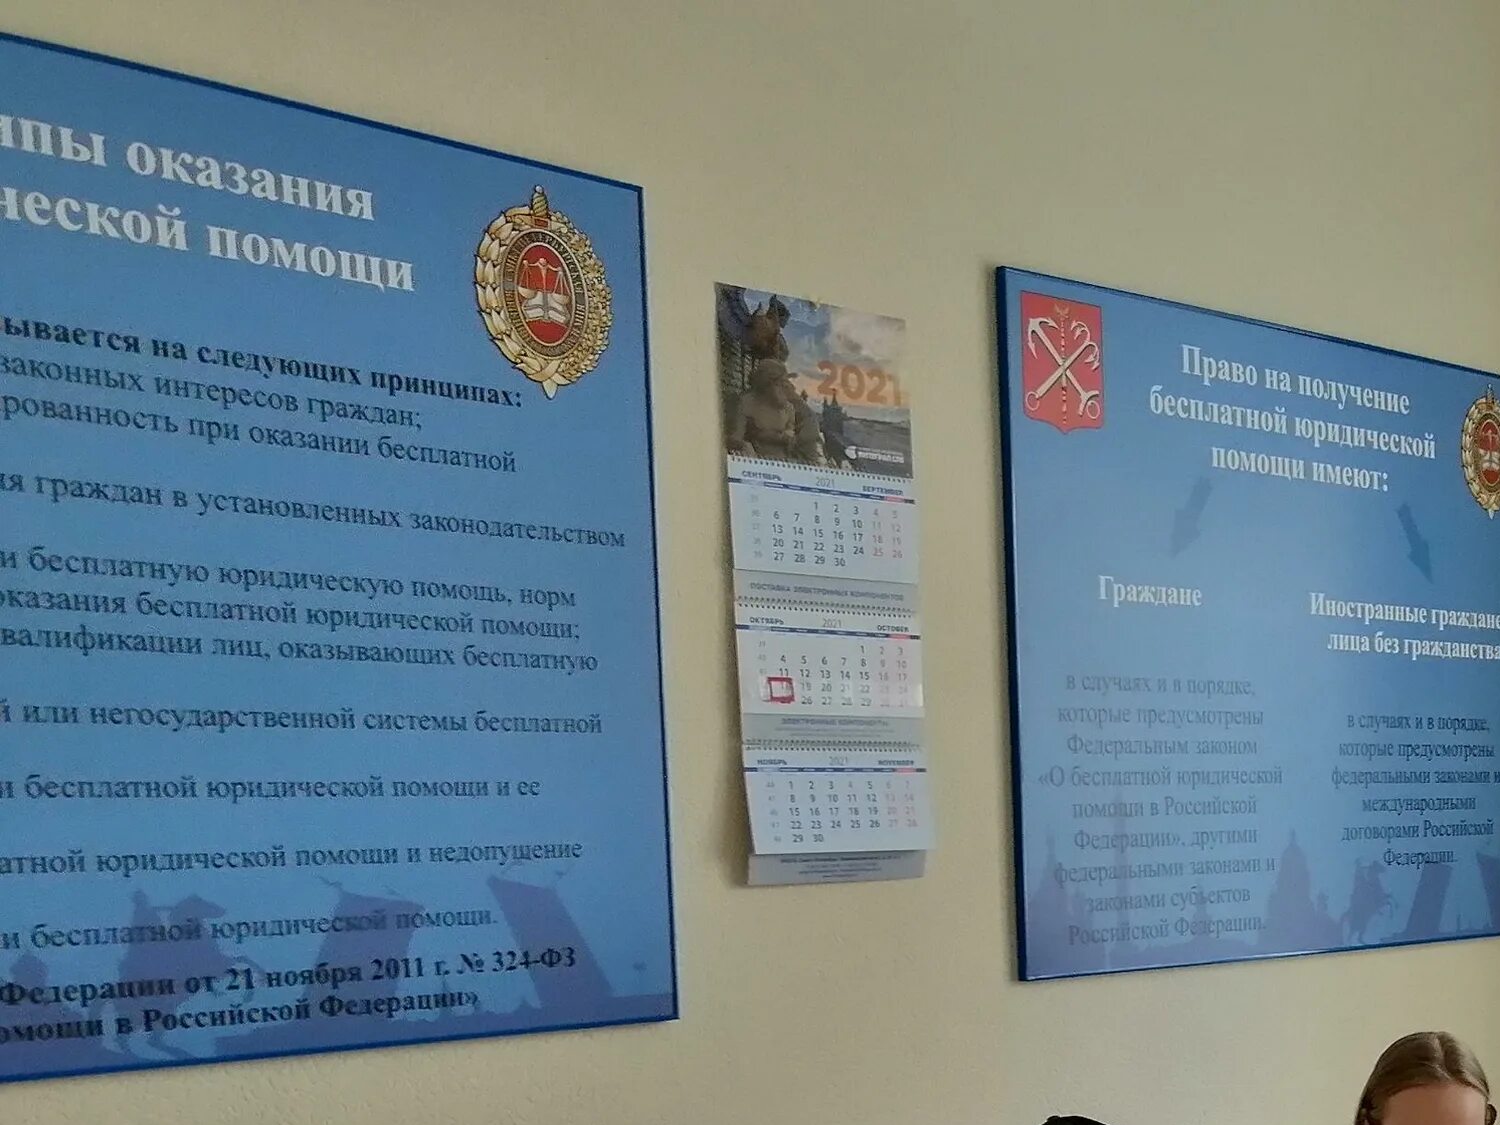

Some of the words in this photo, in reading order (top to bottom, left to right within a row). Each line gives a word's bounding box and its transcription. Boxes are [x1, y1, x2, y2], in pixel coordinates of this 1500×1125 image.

[127, 141, 374, 221] оказания
[208, 224, 415, 293] помощи
[3, 316, 141, 354] ывается
[152, 339, 187, 360] на
[197, 343, 362, 387] следующих
[371, 367, 523, 409] принципах:
[1181, 342, 1257, 388] Право
[1265, 367, 1292, 395] на
[1298, 373, 1410, 417] получение
[817, 360, 902, 406] 2021
[155, 377, 299, 415] интересов
[306, 395, 423, 429] граждан;
[2, 395, 179, 433] рованность
[188, 416, 241, 444] при
[250, 424, 370, 458] оказании
[377, 433, 517, 474] бесплатной
[1149, 384, 1288, 437] бесплатной
[1294, 415, 1435, 461] юридической
[1211, 445, 1305, 483] помощи
[1312, 461, 1389, 493] имеют:
[36, 475, 162, 506] граждан
[197, 489, 401, 529] установленных
[409, 509, 625, 548] законодательством
[28, 545, 209, 585] бесплатную
[218, 563, 404, 599] юридическую
[411, 578, 513, 605] помощь,
[520, 588, 576, 610] норм
[1098, 573, 1202, 608] Граждане
[0, 590, 127, 614] казания
[136, 590, 297, 625] бесплатной
[305, 601, 474, 636] юридической
[481, 619, 580, 641] помощи;
[1309, 592, 1426, 625] Иностранные
[1, 625, 202, 658] валификации
[211, 636, 272, 661] лиц,
[279, 641, 455, 667] оказывающих
[462, 644, 598, 674] бесплатную
[1327, 631, 1370, 655] лица
[1374, 631, 1400, 655] без
[1082, 672, 1151, 696] случаях
[1187, 679, 1255, 699] порядке,
[23, 706, 79, 725] или
[90, 706, 355, 734] негосударственной
[364, 712, 468, 732] системы
[475, 710, 602, 735] бесплатной
[1058, 706, 1130, 727] которые
[1137, 707, 1264, 729] предусмотрены
[1359, 712, 1410, 733] случаях
[1438, 714, 1490, 733] порядке,
[1066, 734, 1190, 758] Федеральным
[1196, 738, 1257, 756] законом
[1339, 740, 1393, 760] которые
[1398, 741, 1495, 762] предусмотрены
[25, 774, 197, 800] бесплатной
[207, 775, 386, 802] юридической
[393, 779, 488, 798] помощи
[517, 779, 540, 797] ее
[1038, 765, 1065, 789] «О
[1072, 764, 1172, 789] бесплатной
[1177, 764, 1282, 789] юридической
[1332, 764, 1430, 787] федеральными
[1434, 768, 1490, 784] законами
[1072, 800, 1144, 821] помощи
[1164, 795, 1256, 819] Российской
[1362, 792, 1476, 815] международными
[1192, 827, 1257, 850] другими
[1342, 820, 1420, 842] договорами
[1423, 817, 1493, 838] Российской
[97, 844, 286, 876] юридической
[295, 845, 398, 868] помощи
[429, 838, 582, 865] недопущение
[1054, 859, 1184, 890] федеральными
[1191, 858, 1261, 877] законами
[1383, 847, 1458, 867] Федерации.
[1086, 892, 1165, 913] законами
[1170, 886, 1251, 911] субъектов
[31, 919, 201, 949] бесплатной
[211, 909, 387, 945] юридической
[395, 906, 498, 930] помощи.
[1068, 919, 1168, 948] Российской
[1174, 913, 1266, 938] Федерации.
[0, 972, 175, 1006] Федерации
[186, 974, 215, 995] от
[225, 967, 254, 991] 21
[266, 962, 362, 990] ноября
[371, 956, 424, 981] 2011
[435, 958, 450, 977] г.
[492, 946, 577, 974] 324-ФЗ
[143, 997, 311, 1036] Российской
[319, 988, 480, 1019] Федерации»
